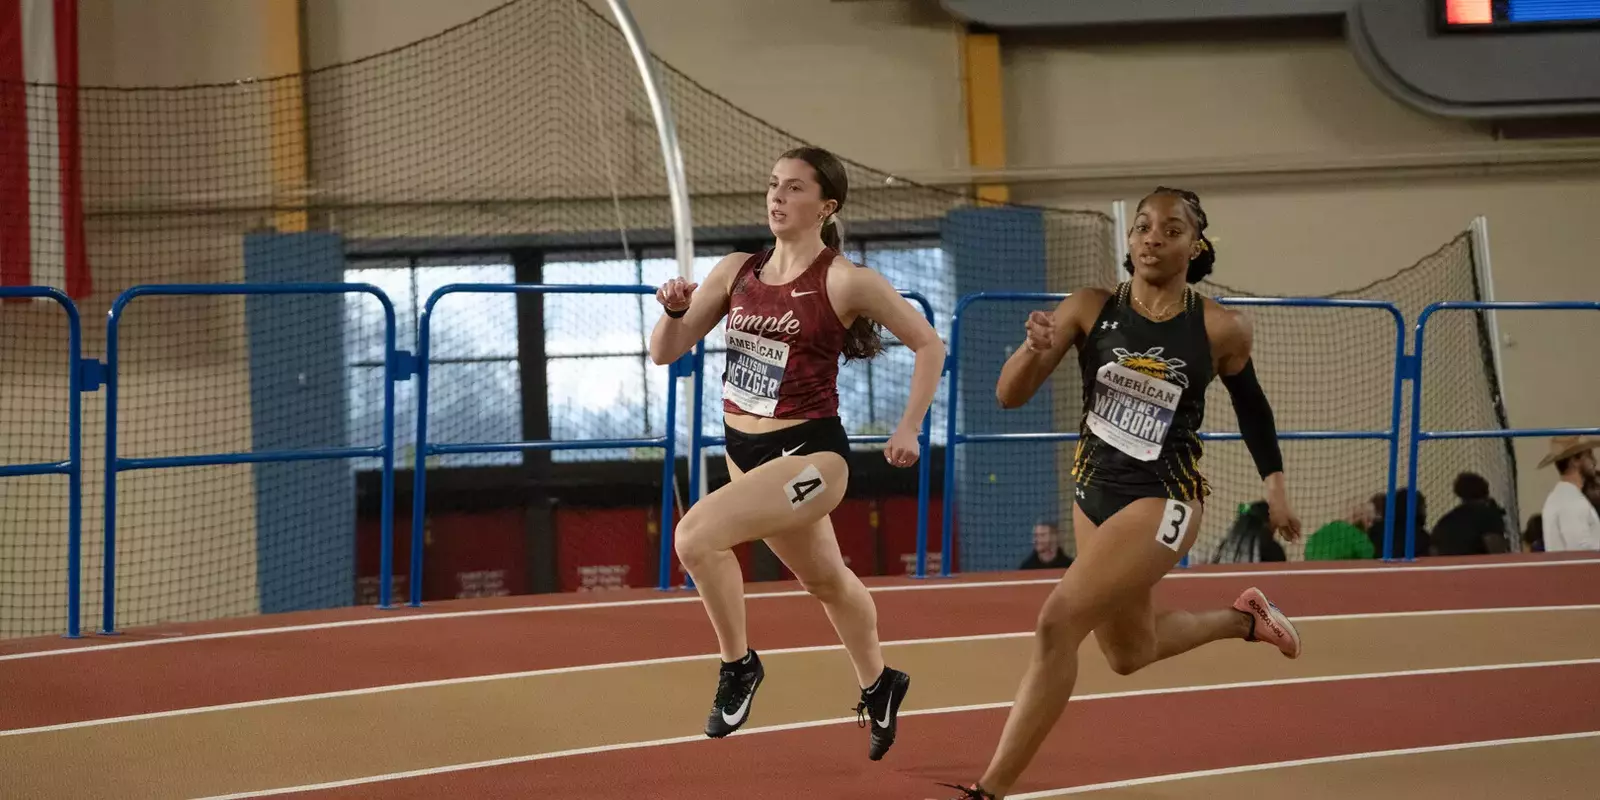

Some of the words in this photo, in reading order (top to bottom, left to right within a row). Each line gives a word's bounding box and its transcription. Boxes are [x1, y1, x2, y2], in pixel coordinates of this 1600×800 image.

[728, 306, 801, 336] Temple
[727, 360, 778, 398] METZGER
[737, 354, 768, 375] ALLYSON
[1103, 370, 1175, 403] AMERICAN
[1094, 392, 1167, 443] WILBORN
[1107, 388, 1160, 417] COURTNEY
[791, 477, 822, 504] 4
[1162, 504, 1186, 545] 3
